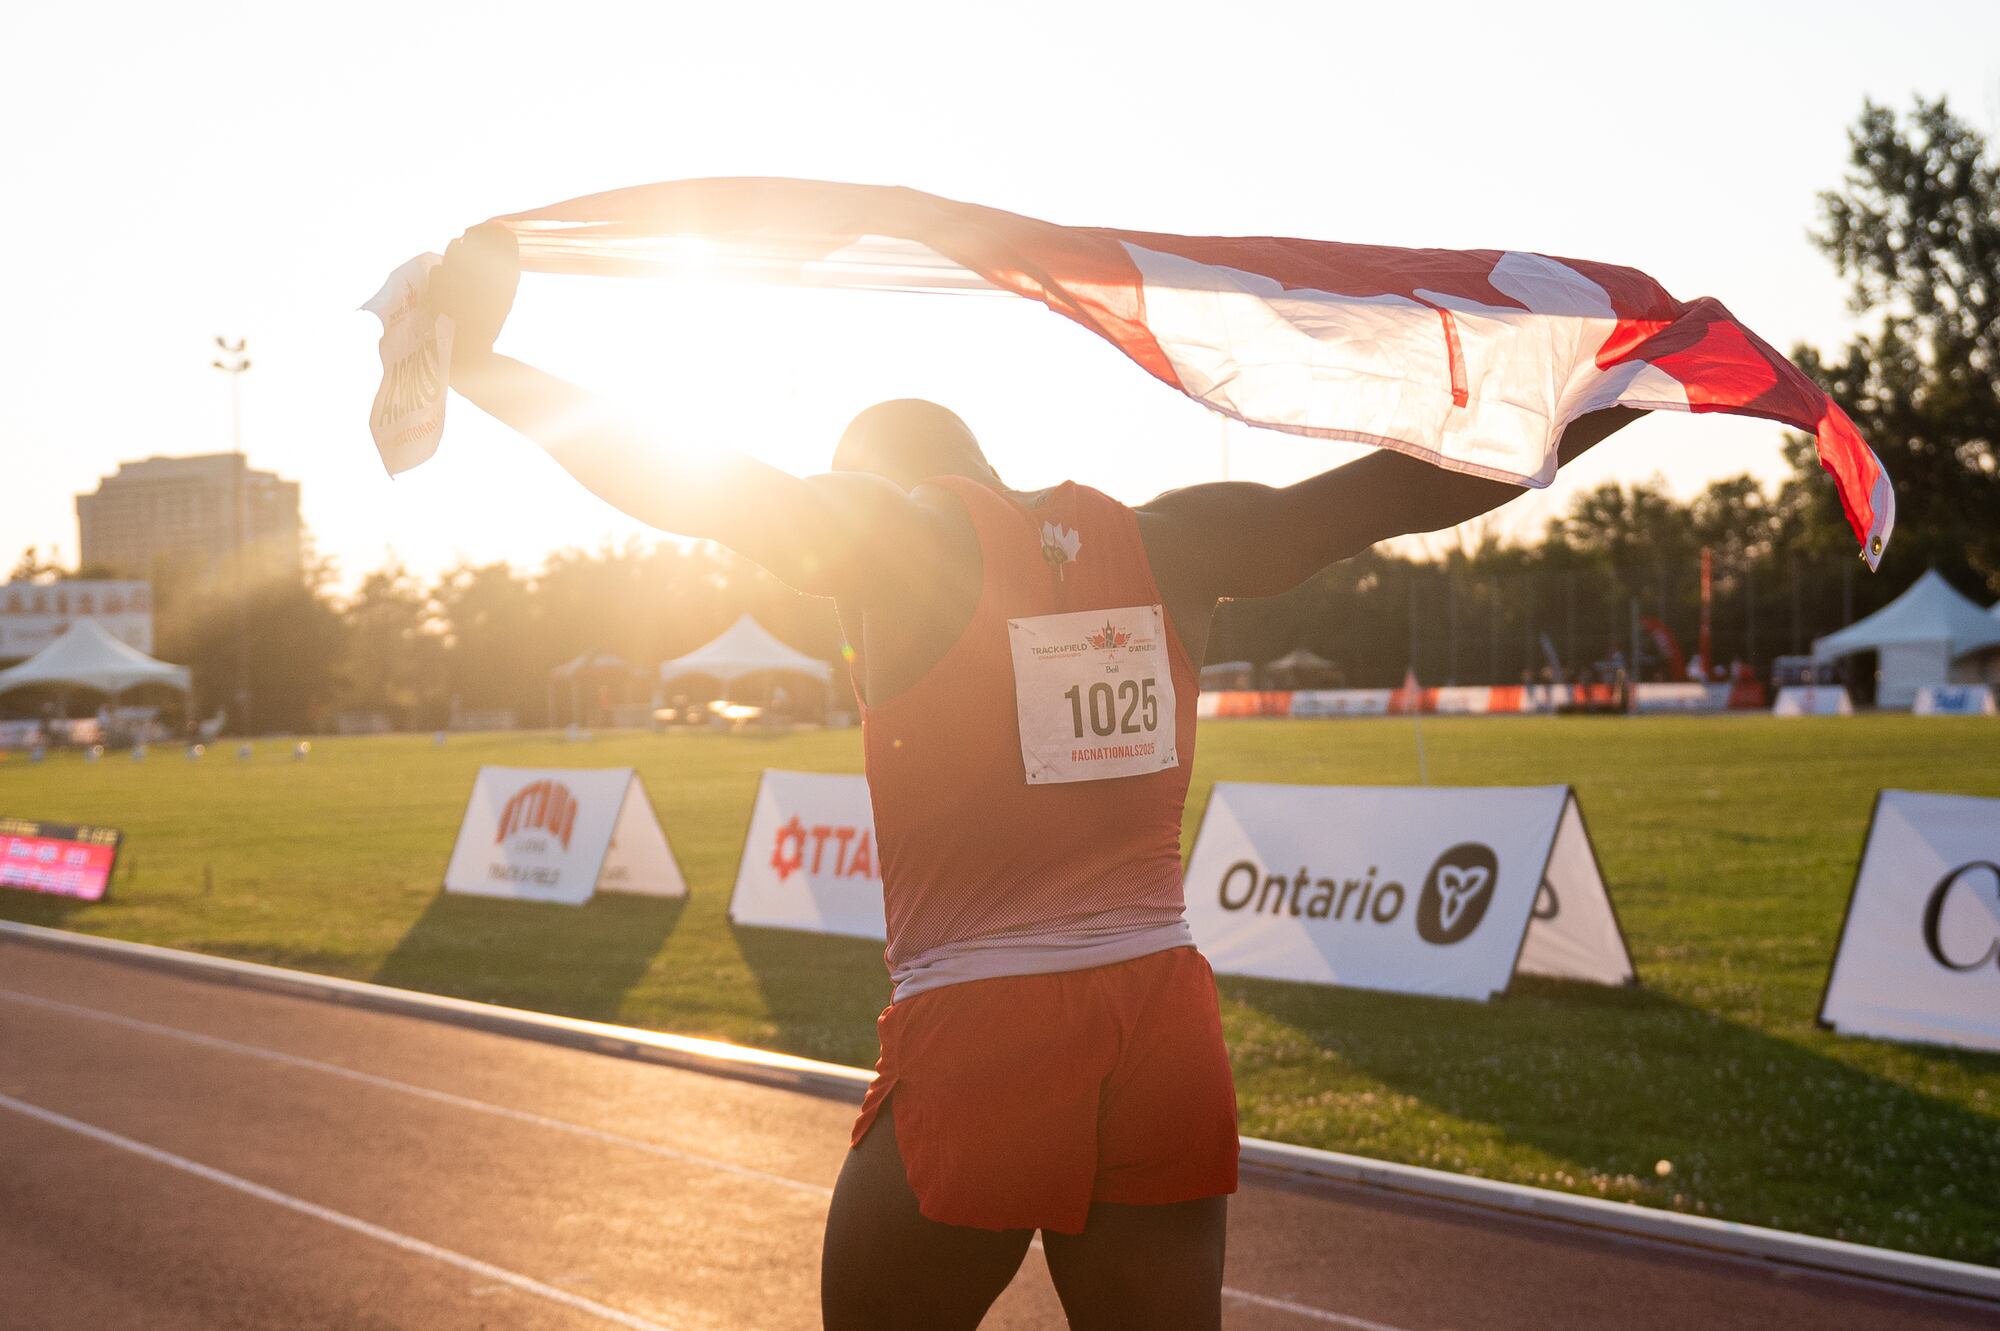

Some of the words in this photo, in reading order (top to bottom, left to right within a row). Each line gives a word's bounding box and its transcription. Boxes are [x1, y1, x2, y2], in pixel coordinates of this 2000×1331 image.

[1106, 665, 1119, 674] Bell
[1065, 678, 1158, 738] 1025
[1071, 743, 1155, 762] #ACNATIONALS2025
[770, 813, 881, 883] OTTA
[1218, 860, 1405, 925] Ontario
[1923, 860, 2000, 972] C
